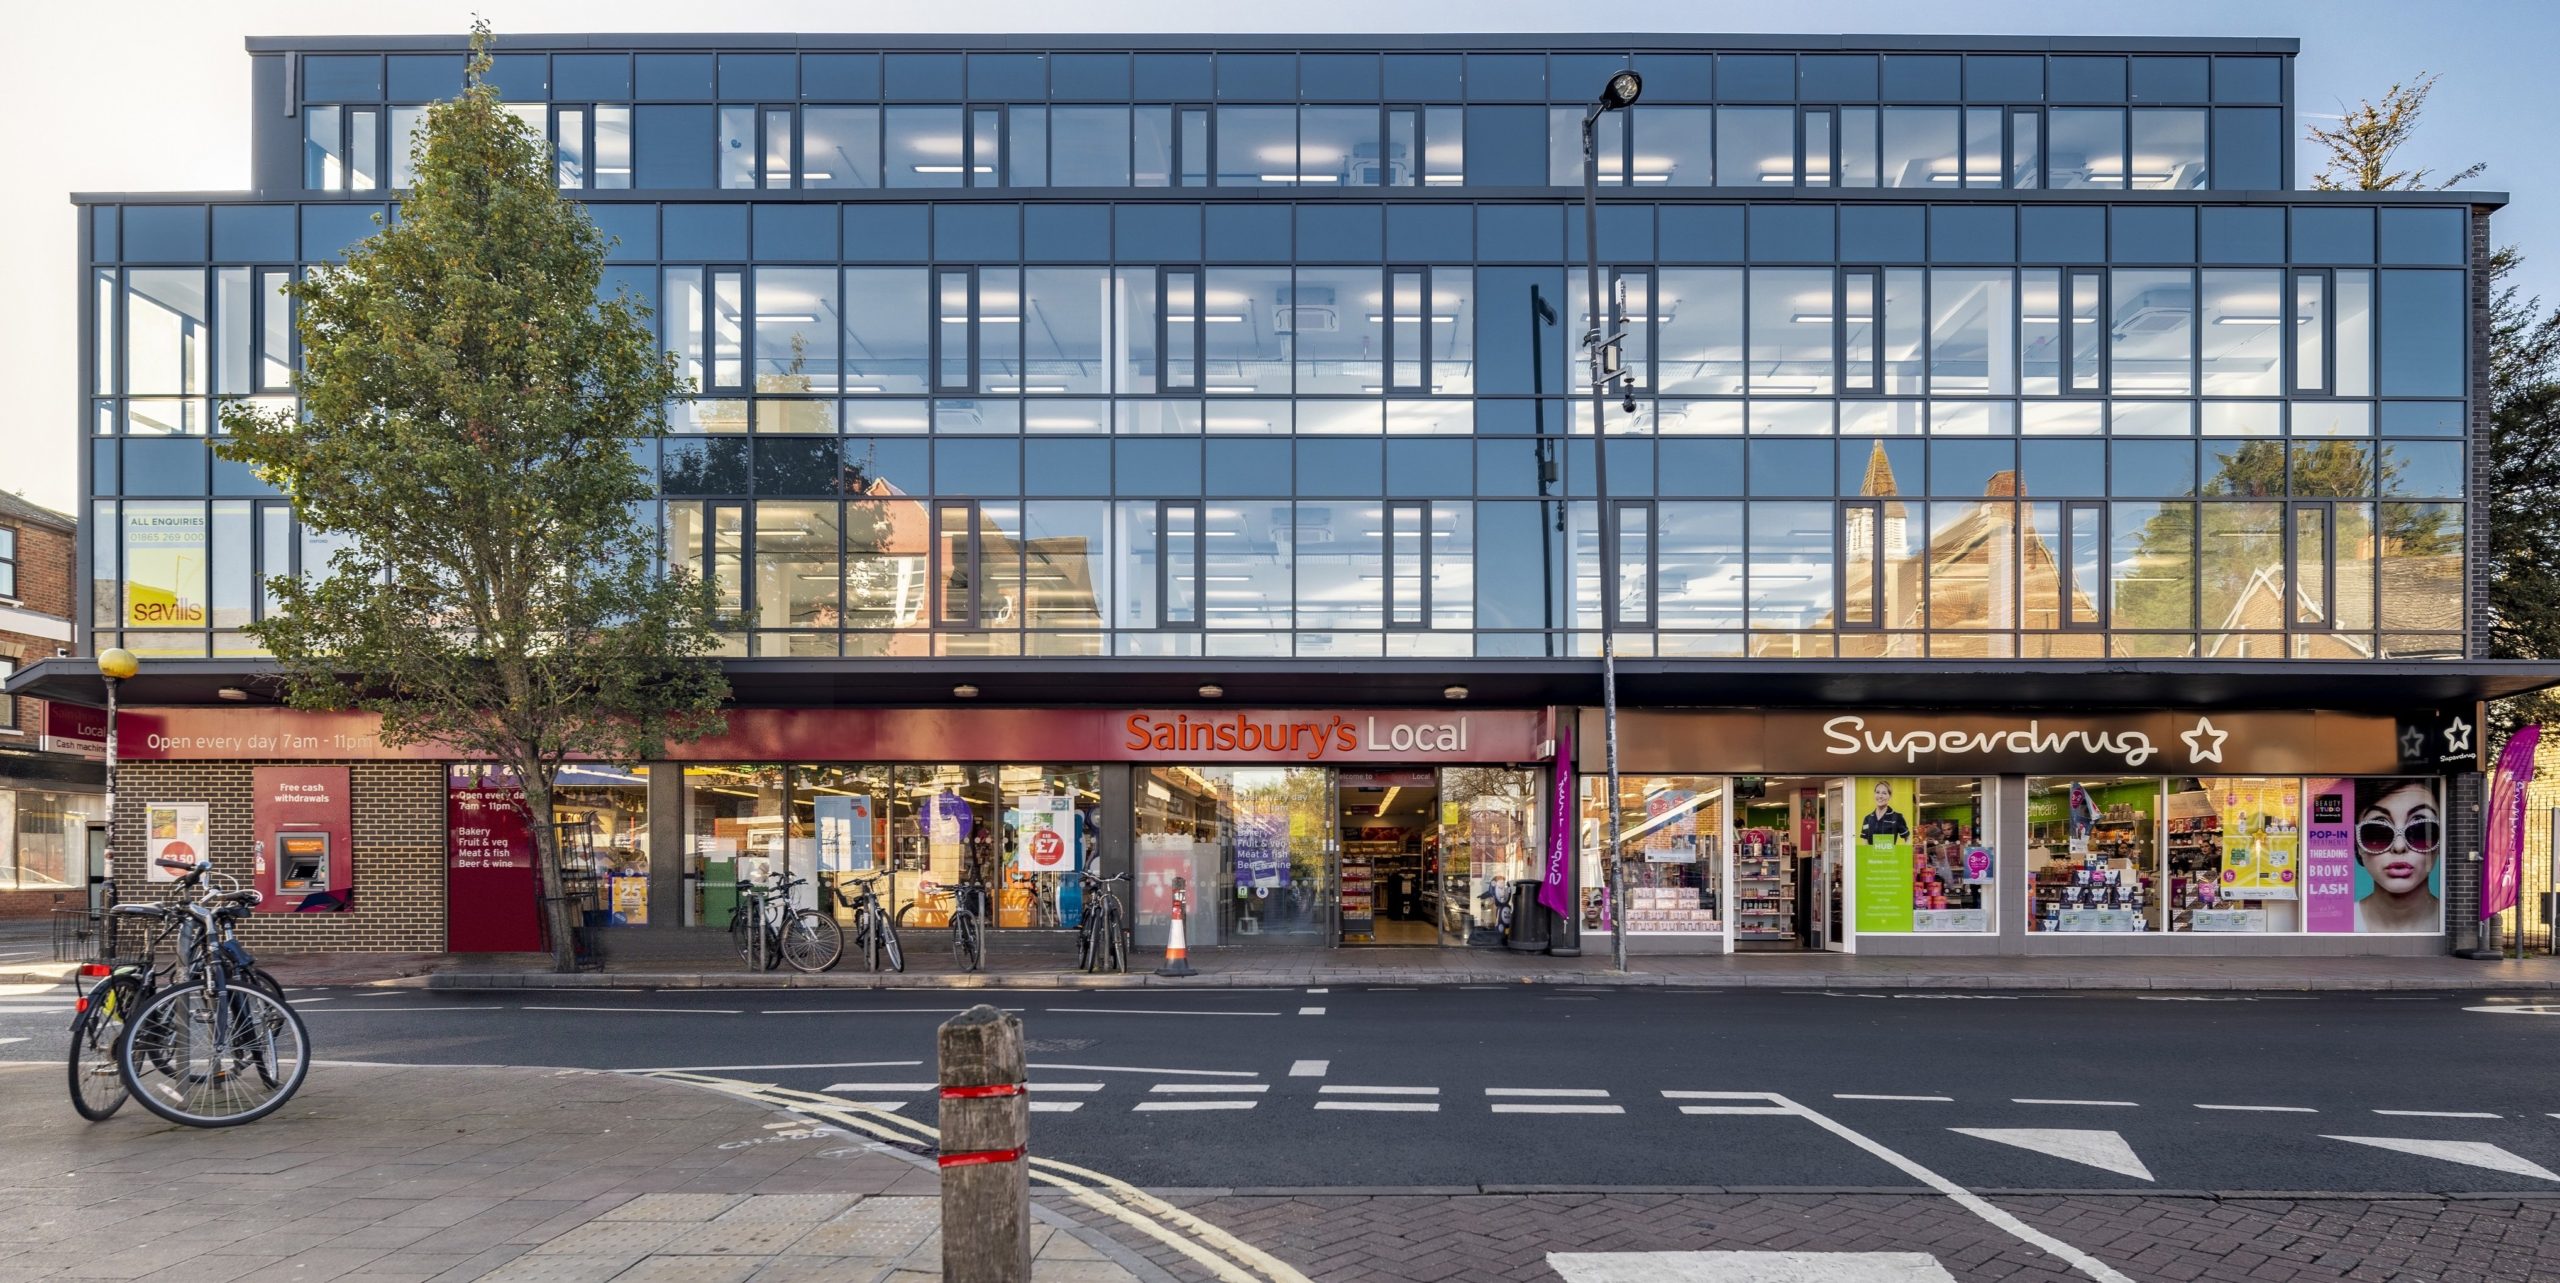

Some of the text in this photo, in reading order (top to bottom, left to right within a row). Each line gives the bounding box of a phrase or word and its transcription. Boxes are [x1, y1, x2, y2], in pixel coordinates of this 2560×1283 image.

[131, 517, 204, 526] ALL ENQUIRIES
[130, 533, 205, 542] 01865 269 000
[134, 597, 203, 621] savills
[78, 723, 107, 739] Local
[1125, 714, 1466, 760] Sainsbury's Local
[1822, 715, 2159, 767] Superdrug
[56, 739, 107, 753] Cash machine
[147, 734, 191, 752] Open
[196, 736, 243, 751] every
[247, 734, 277, 752] day
[283, 734, 318, 749] 7am
[334, 735, 372, 752] 11pm
[2440, 753, 2477, 762] Superdrug
[280, 783, 324, 792] Free cash
[275, 794, 330, 803] withdrawals
[459, 791, 482, 801] Open
[459, 802, 479, 810] 7am
[489, 802, 511, 811] 11pm
[459, 827, 491, 837] Bakery
[2309, 830, 2348, 839] POP-IN
[459, 838, 508, 848] Fruit & veg
[1036, 838, 1059, 854] £7
[459, 848, 510, 857] Meat & fish
[1238, 850, 1259, 858] Meat
[2309, 849, 2348, 859] THREADING
[459, 859, 513, 868] Beer & wine
[2309, 864, 2348, 877] BROWS
[2309, 883, 2349, 895] LASH
